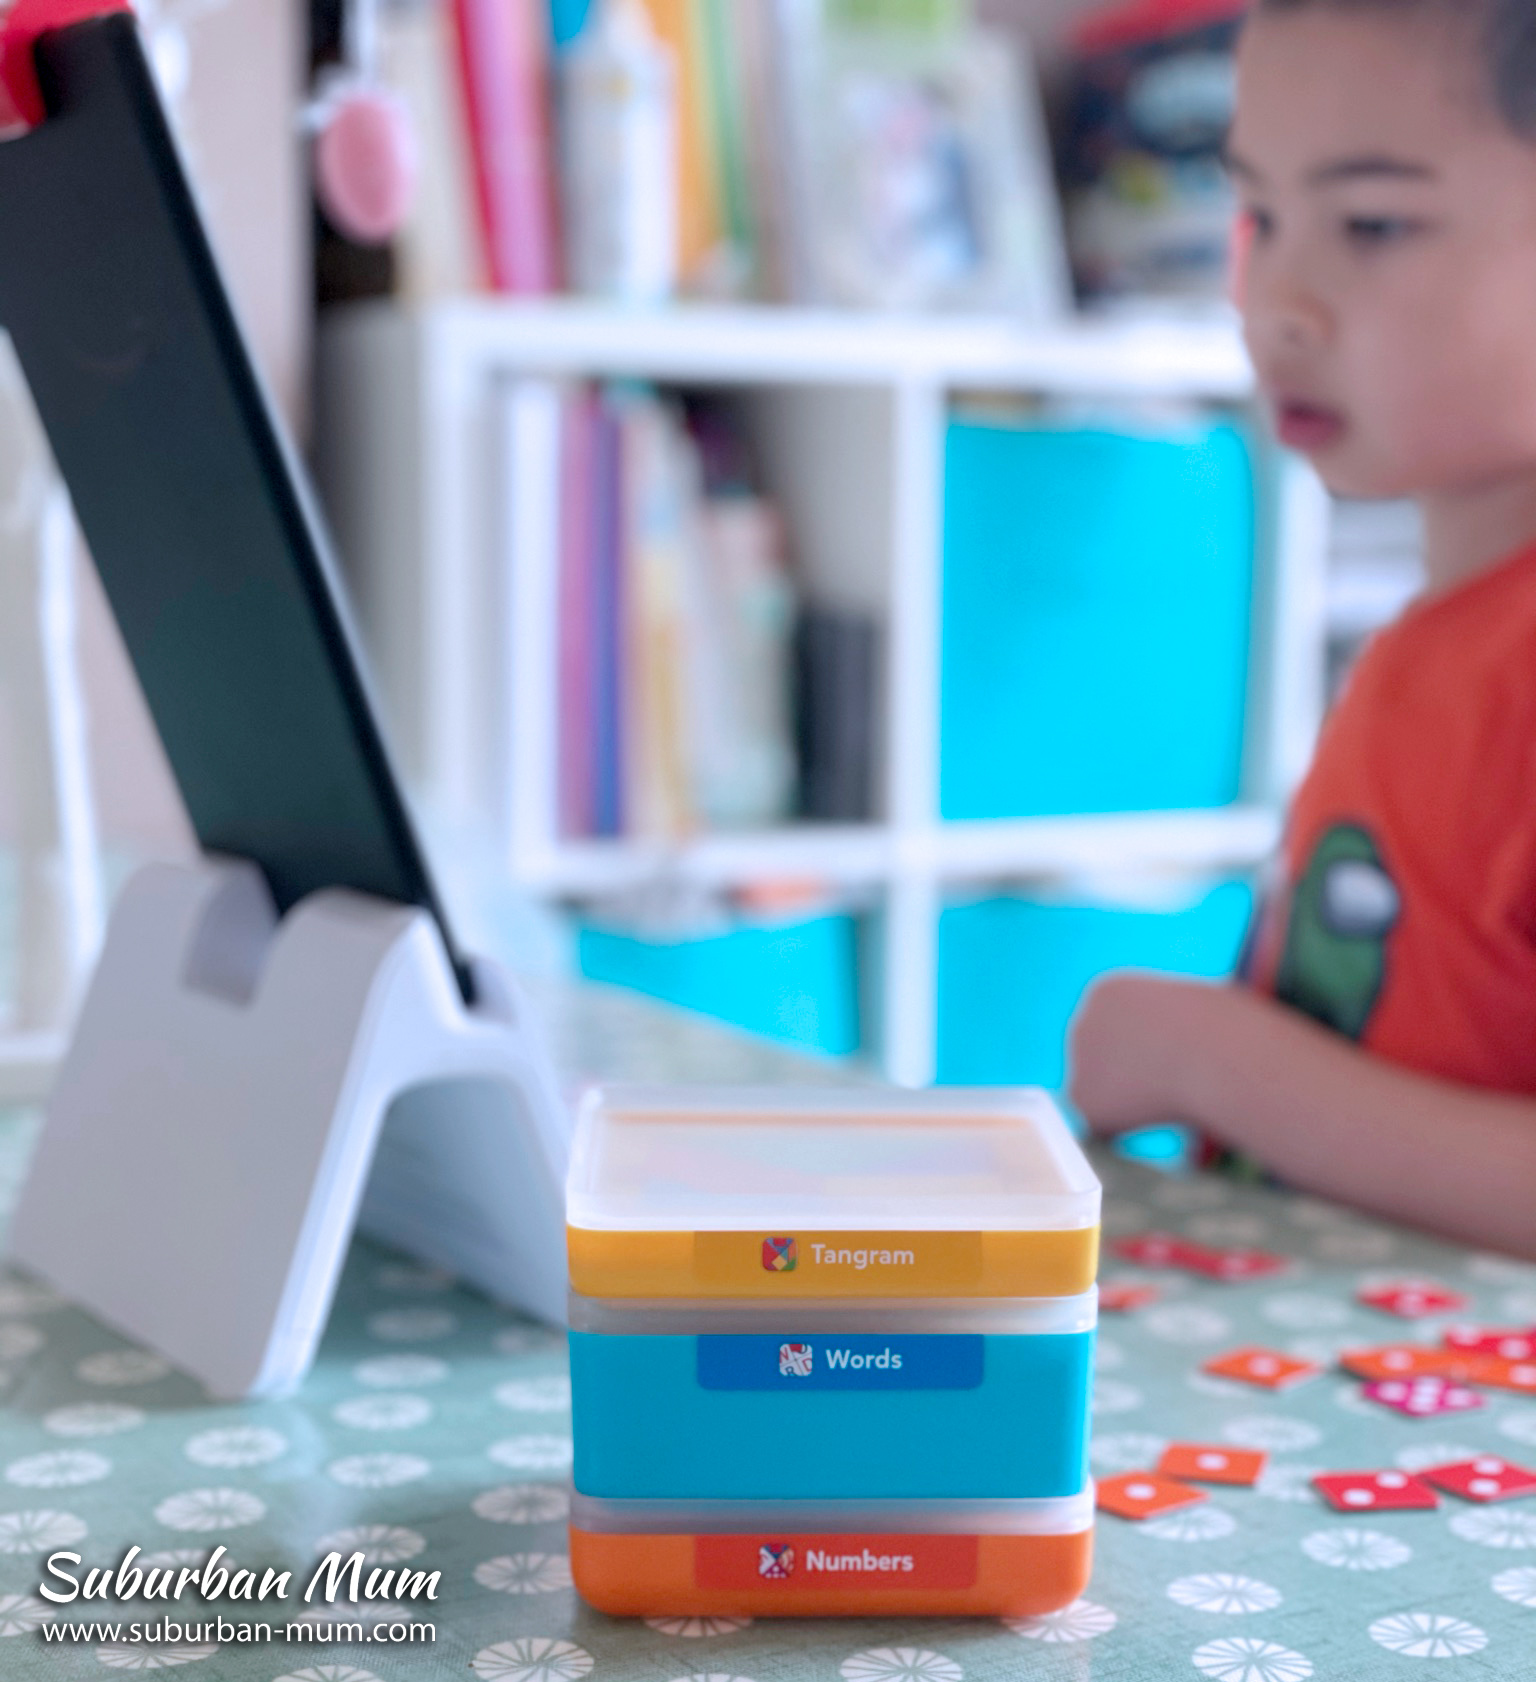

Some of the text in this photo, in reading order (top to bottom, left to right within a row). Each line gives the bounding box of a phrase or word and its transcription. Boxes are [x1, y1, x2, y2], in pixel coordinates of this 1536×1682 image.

[810, 1243, 915, 1270] Tangram
[825, 1347, 903, 1370] Words
[806, 1548, 914, 1572] Numbers
